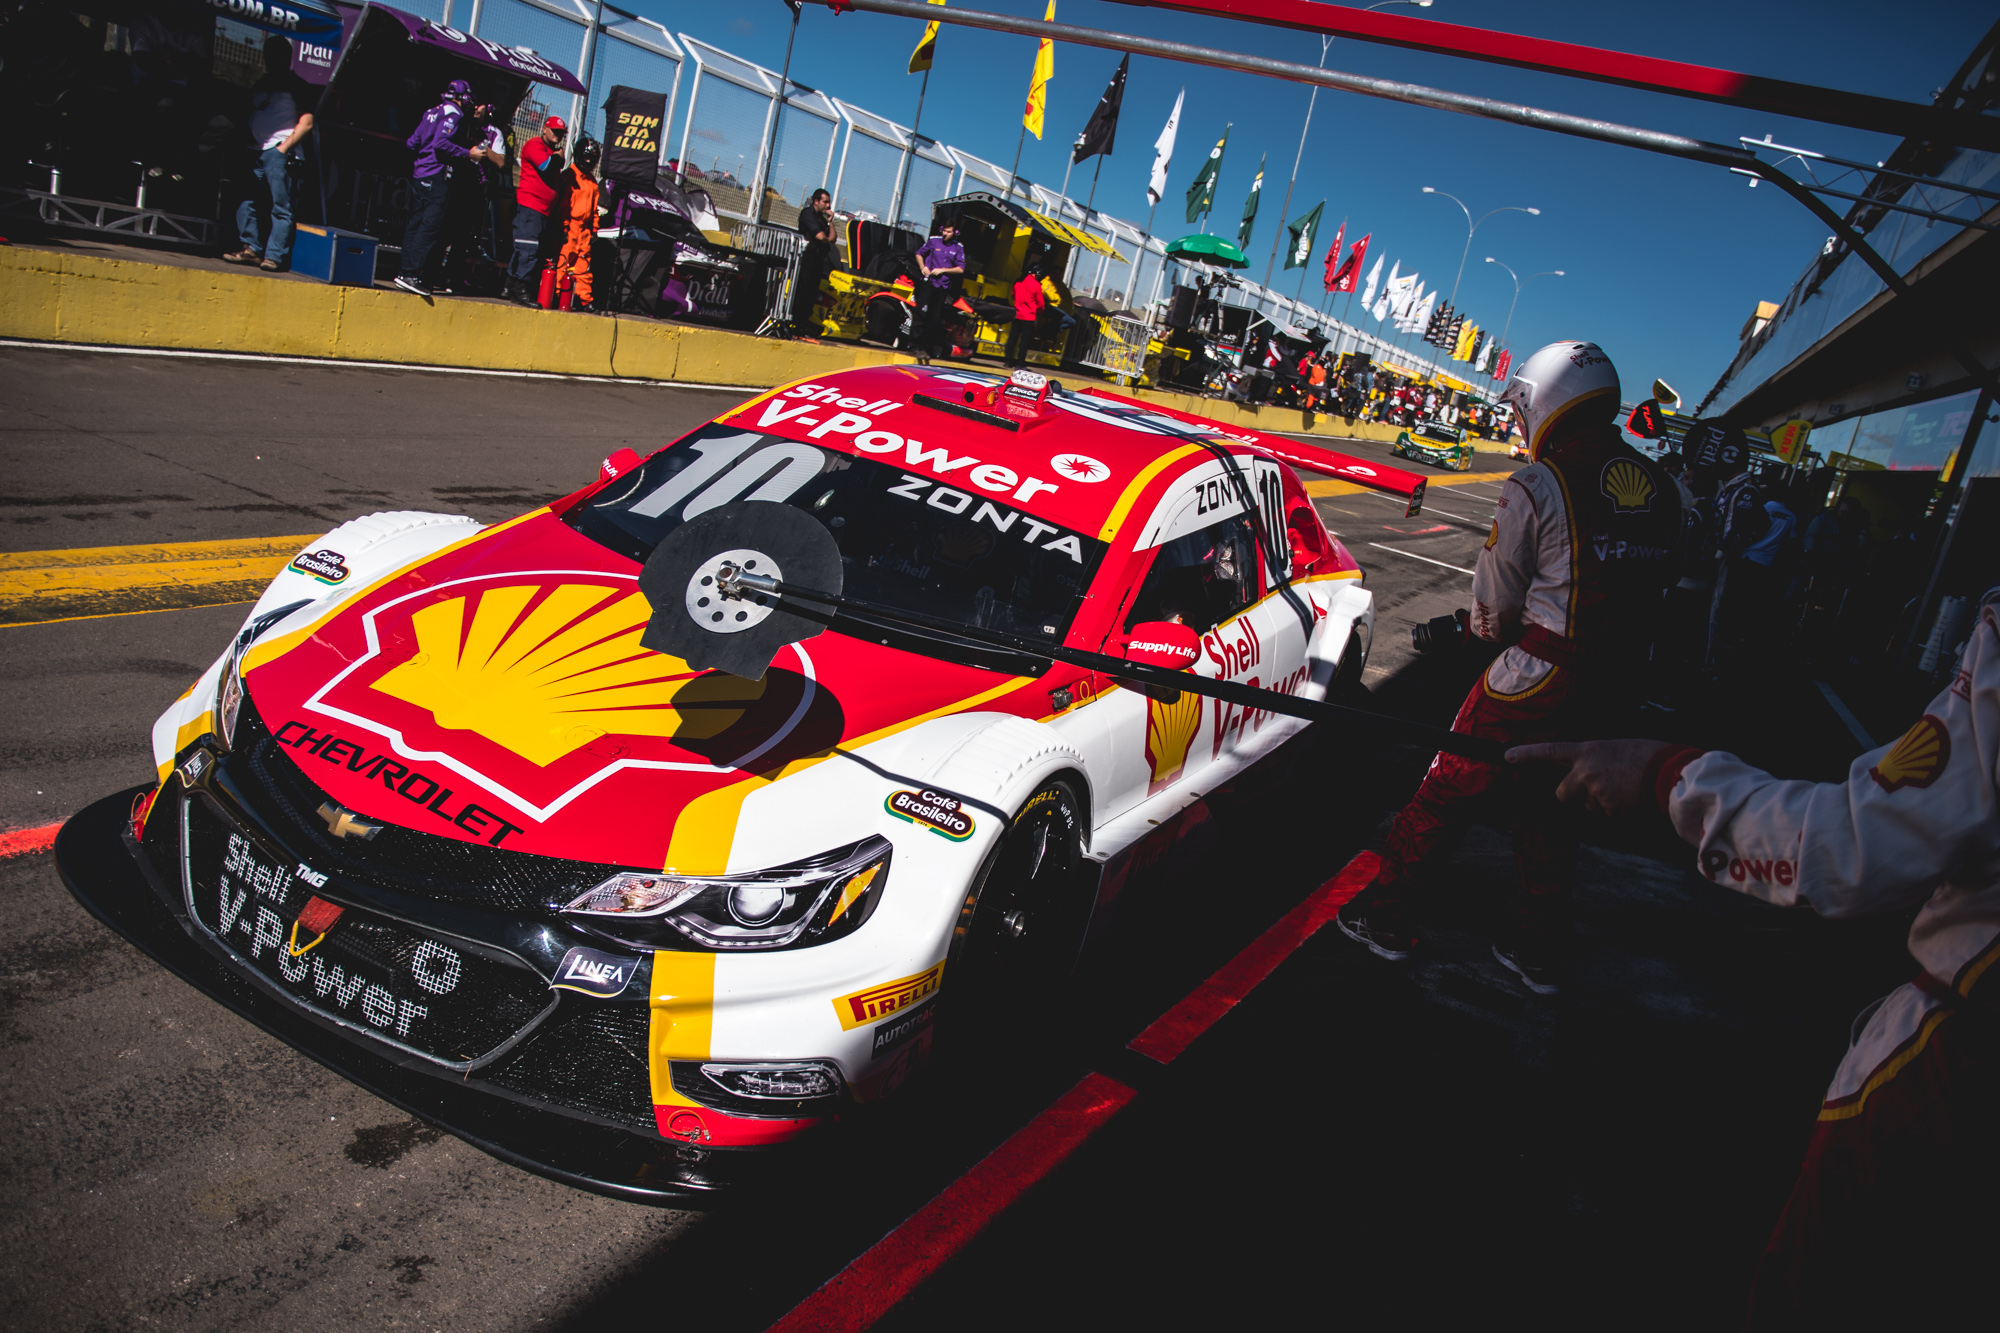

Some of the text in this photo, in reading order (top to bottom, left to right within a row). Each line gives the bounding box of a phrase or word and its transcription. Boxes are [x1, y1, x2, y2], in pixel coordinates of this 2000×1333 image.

[617, 112, 659, 128] SOM
[614, 136, 657, 153] ILHA
[783, 384, 904, 415] Shell
[756, 399, 1060, 503] V-Power
[628, 433, 826, 523] 10
[1195, 472, 1250, 516] ZONTA
[887, 474, 1084, 564] ZONTA
[1259, 469, 1290, 578] 10
[296, 554, 344, 579] Brasileiro
[317, 550, 342, 565] Café
[1202, 615, 1260, 681] Shell
[274, 720, 525, 848] CHEVROLET
[921, 790, 960, 810] Café
[894, 793, 966, 831] Brasileiro
[223, 832, 294, 905] Shell
[296, 863, 328, 888] TMG
[220, 874, 429, 1038] V-Power
[563, 954, 623, 985] LINEA
[848, 967, 939, 1023] PIRELLI
